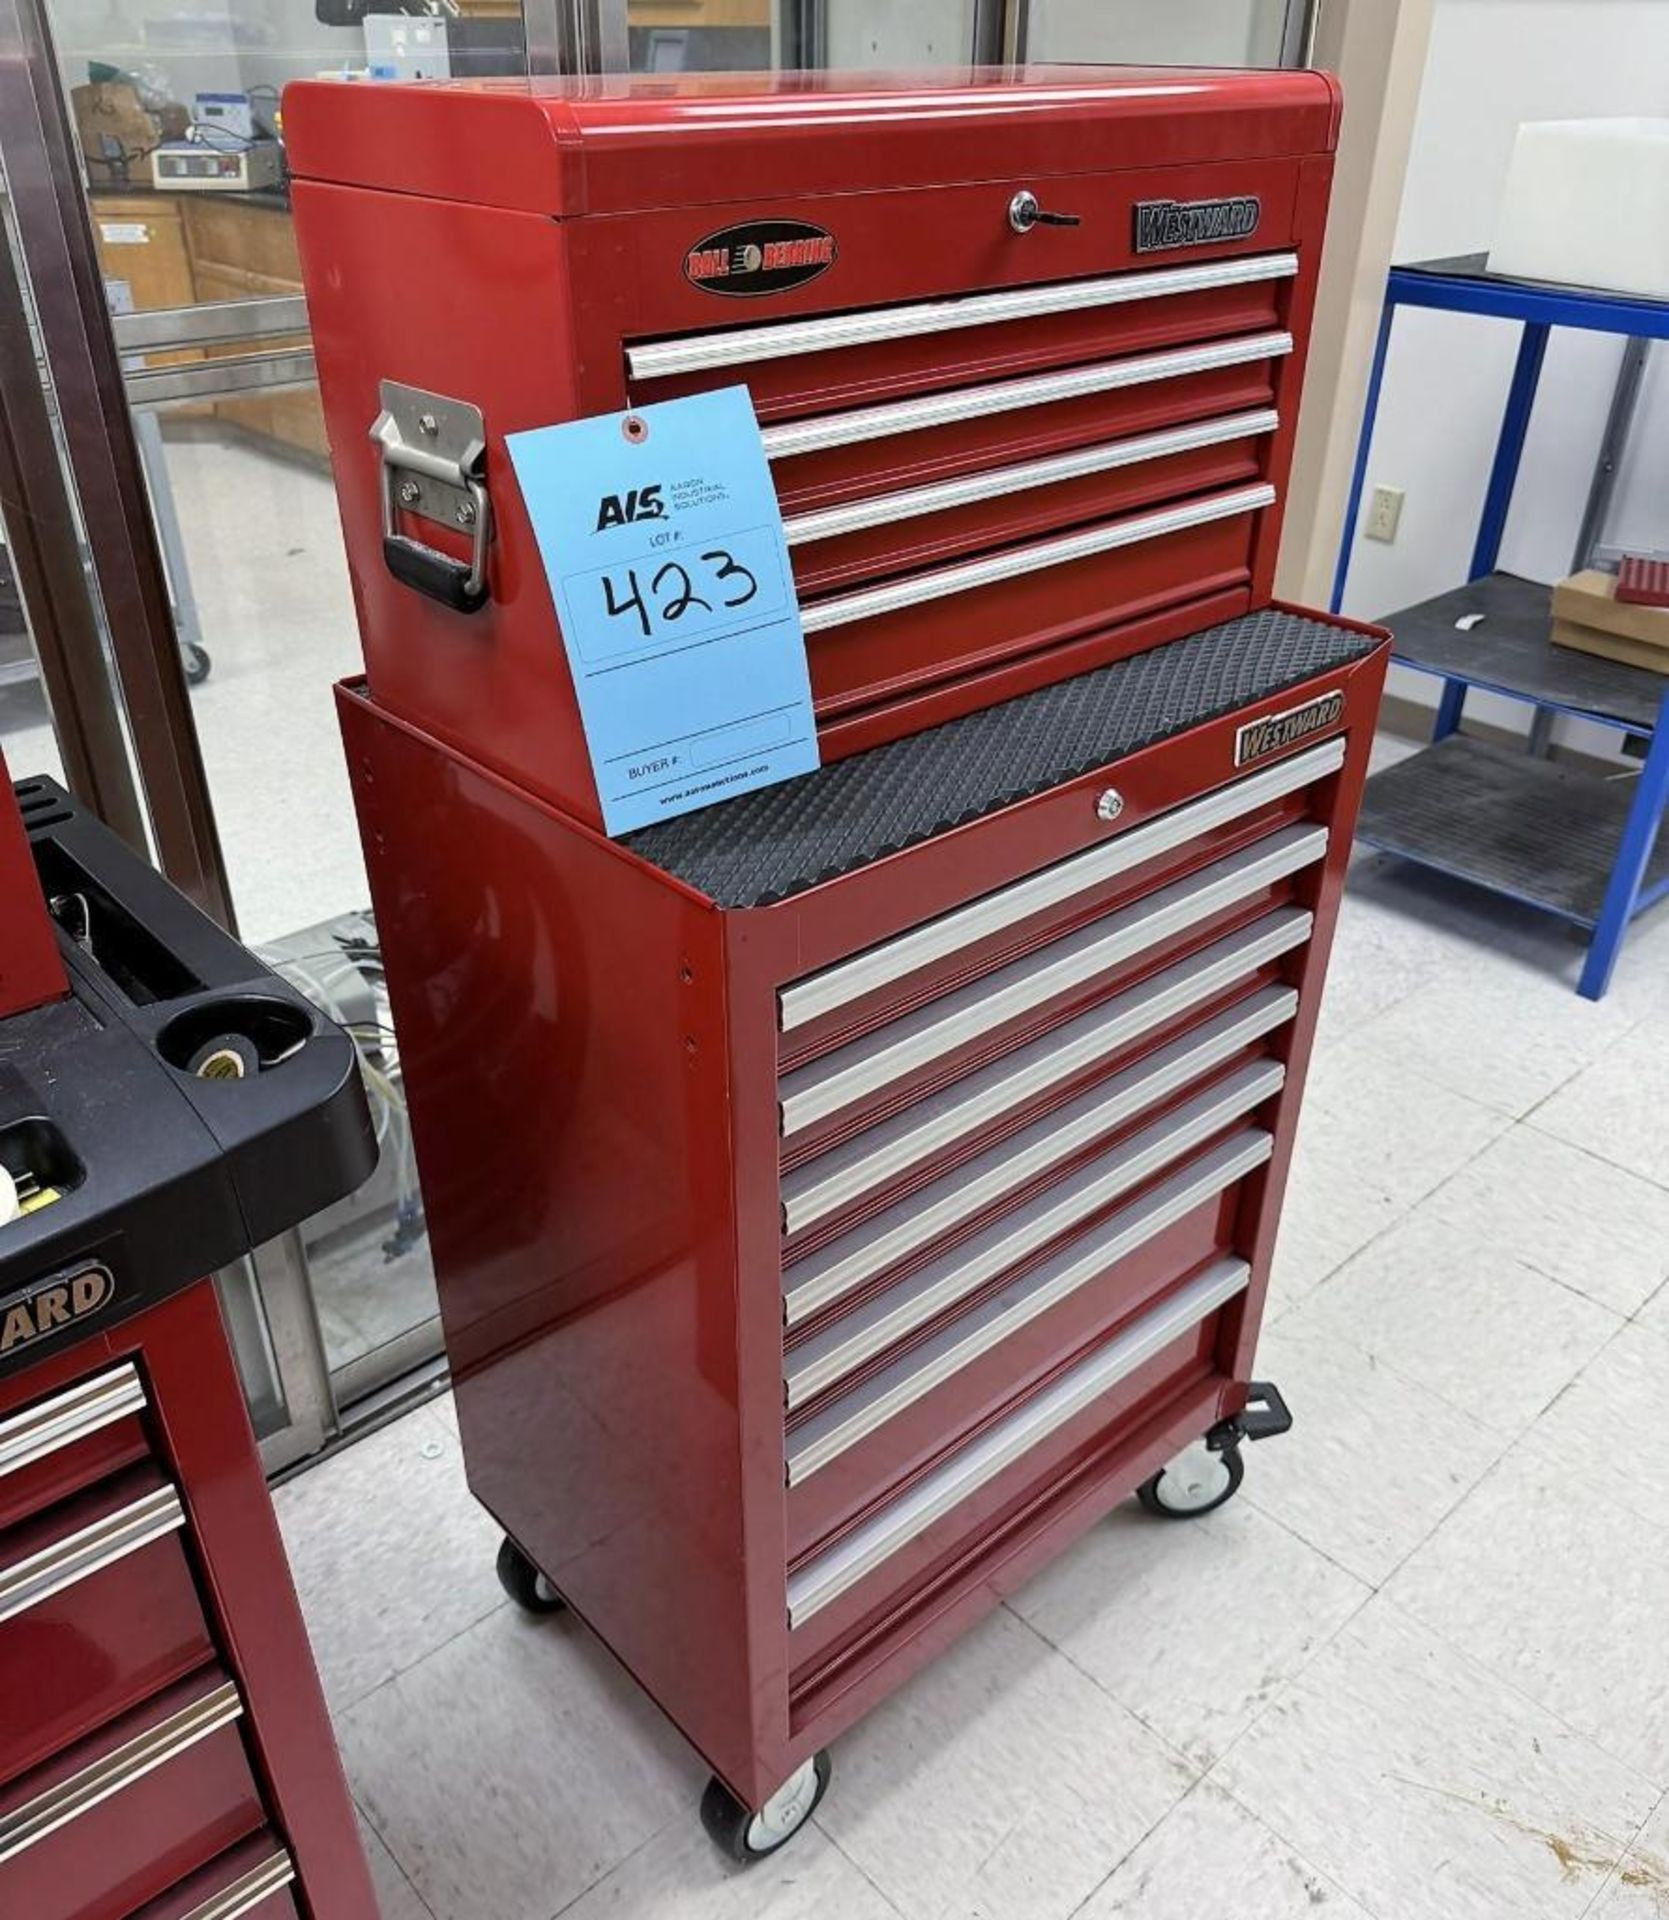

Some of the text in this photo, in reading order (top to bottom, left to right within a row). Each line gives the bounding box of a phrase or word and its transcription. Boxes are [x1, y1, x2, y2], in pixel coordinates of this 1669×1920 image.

[1141, 201, 1258, 248] WESTWARD
[688, 248, 730, 280] BALL
[596, 484, 669, 532] AIS
[649, 532, 671, 548] LOT
[601, 550, 757, 635] 423
[1241, 697, 1341, 760] WESTWARD
[628, 757, 670, 780] BUYER
